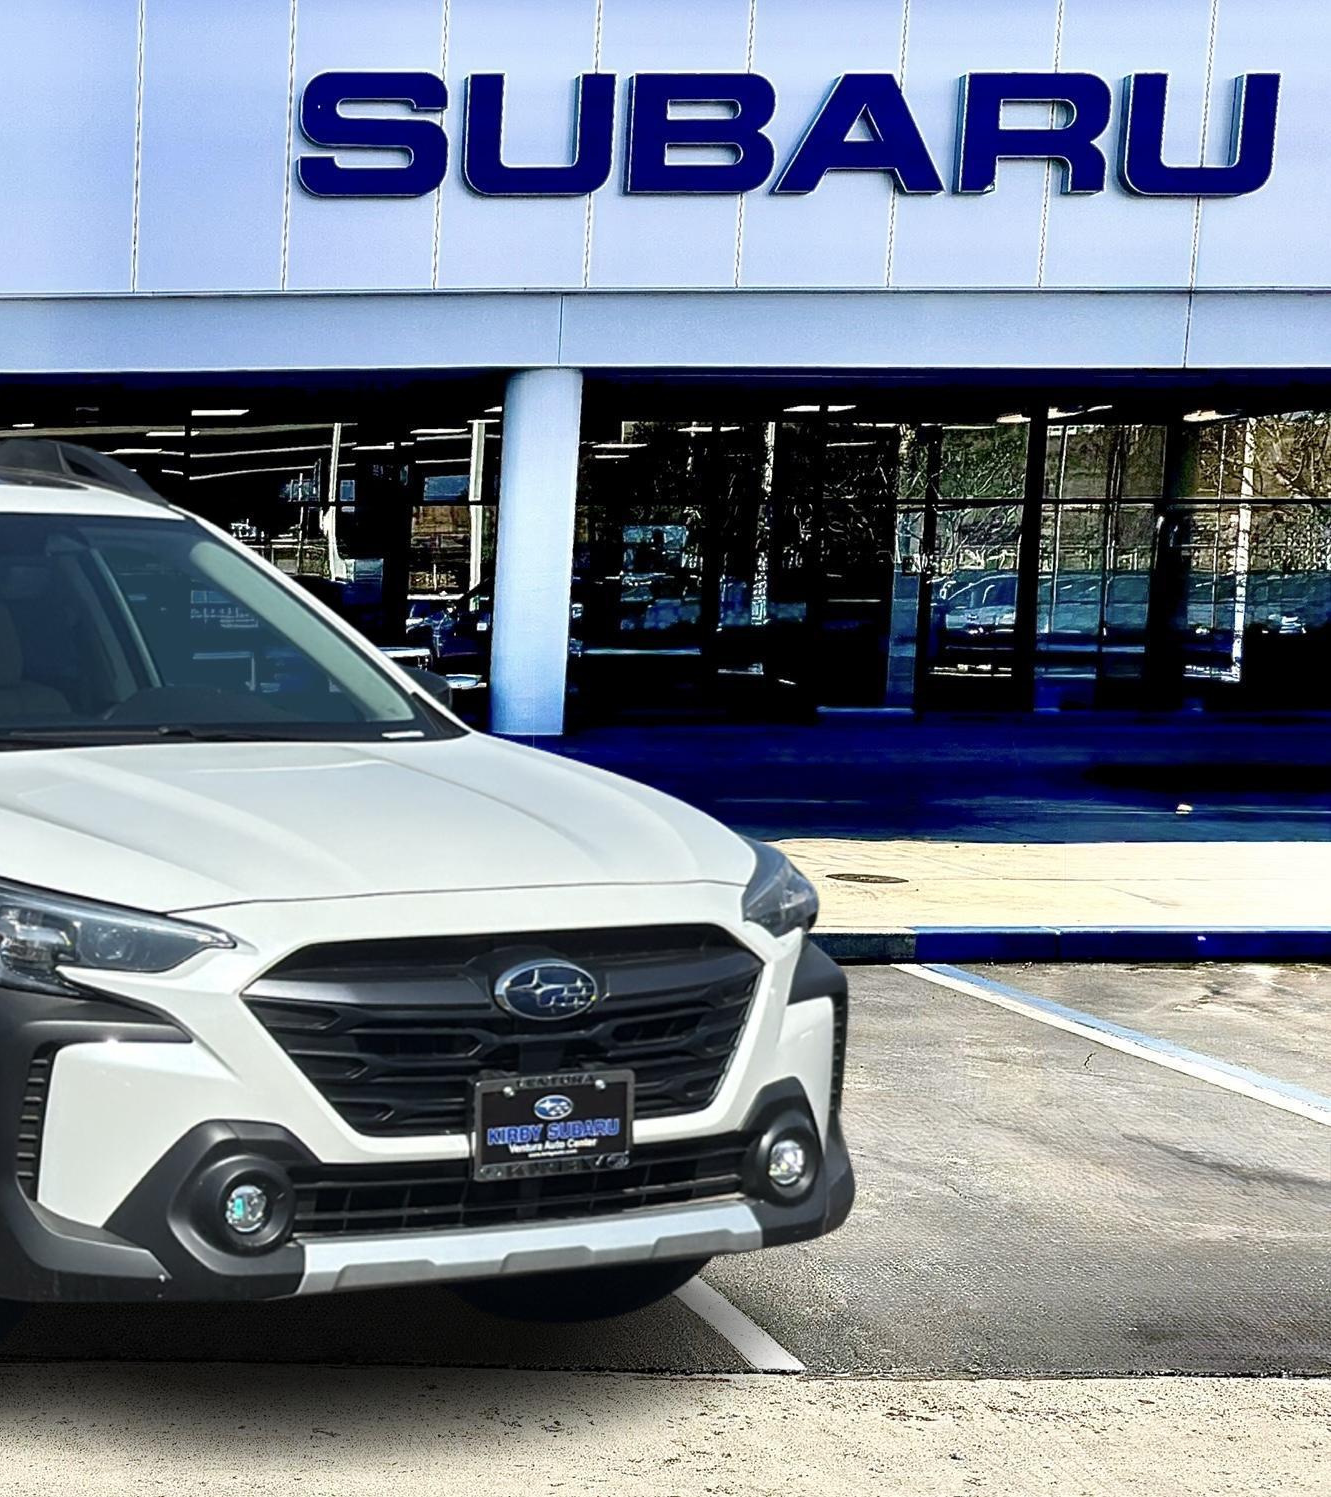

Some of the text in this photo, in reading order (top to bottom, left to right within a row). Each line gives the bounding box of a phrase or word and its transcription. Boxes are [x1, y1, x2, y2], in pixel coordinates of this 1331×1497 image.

[297, 70, 1282, 198] SUBARU
[487, 1118, 620, 1146] KIRBY SUBARU
[509, 1140, 543, 1154] Ventura
[545, 1138, 566, 1150] Auto
[566, 1137, 598, 1149] Center
